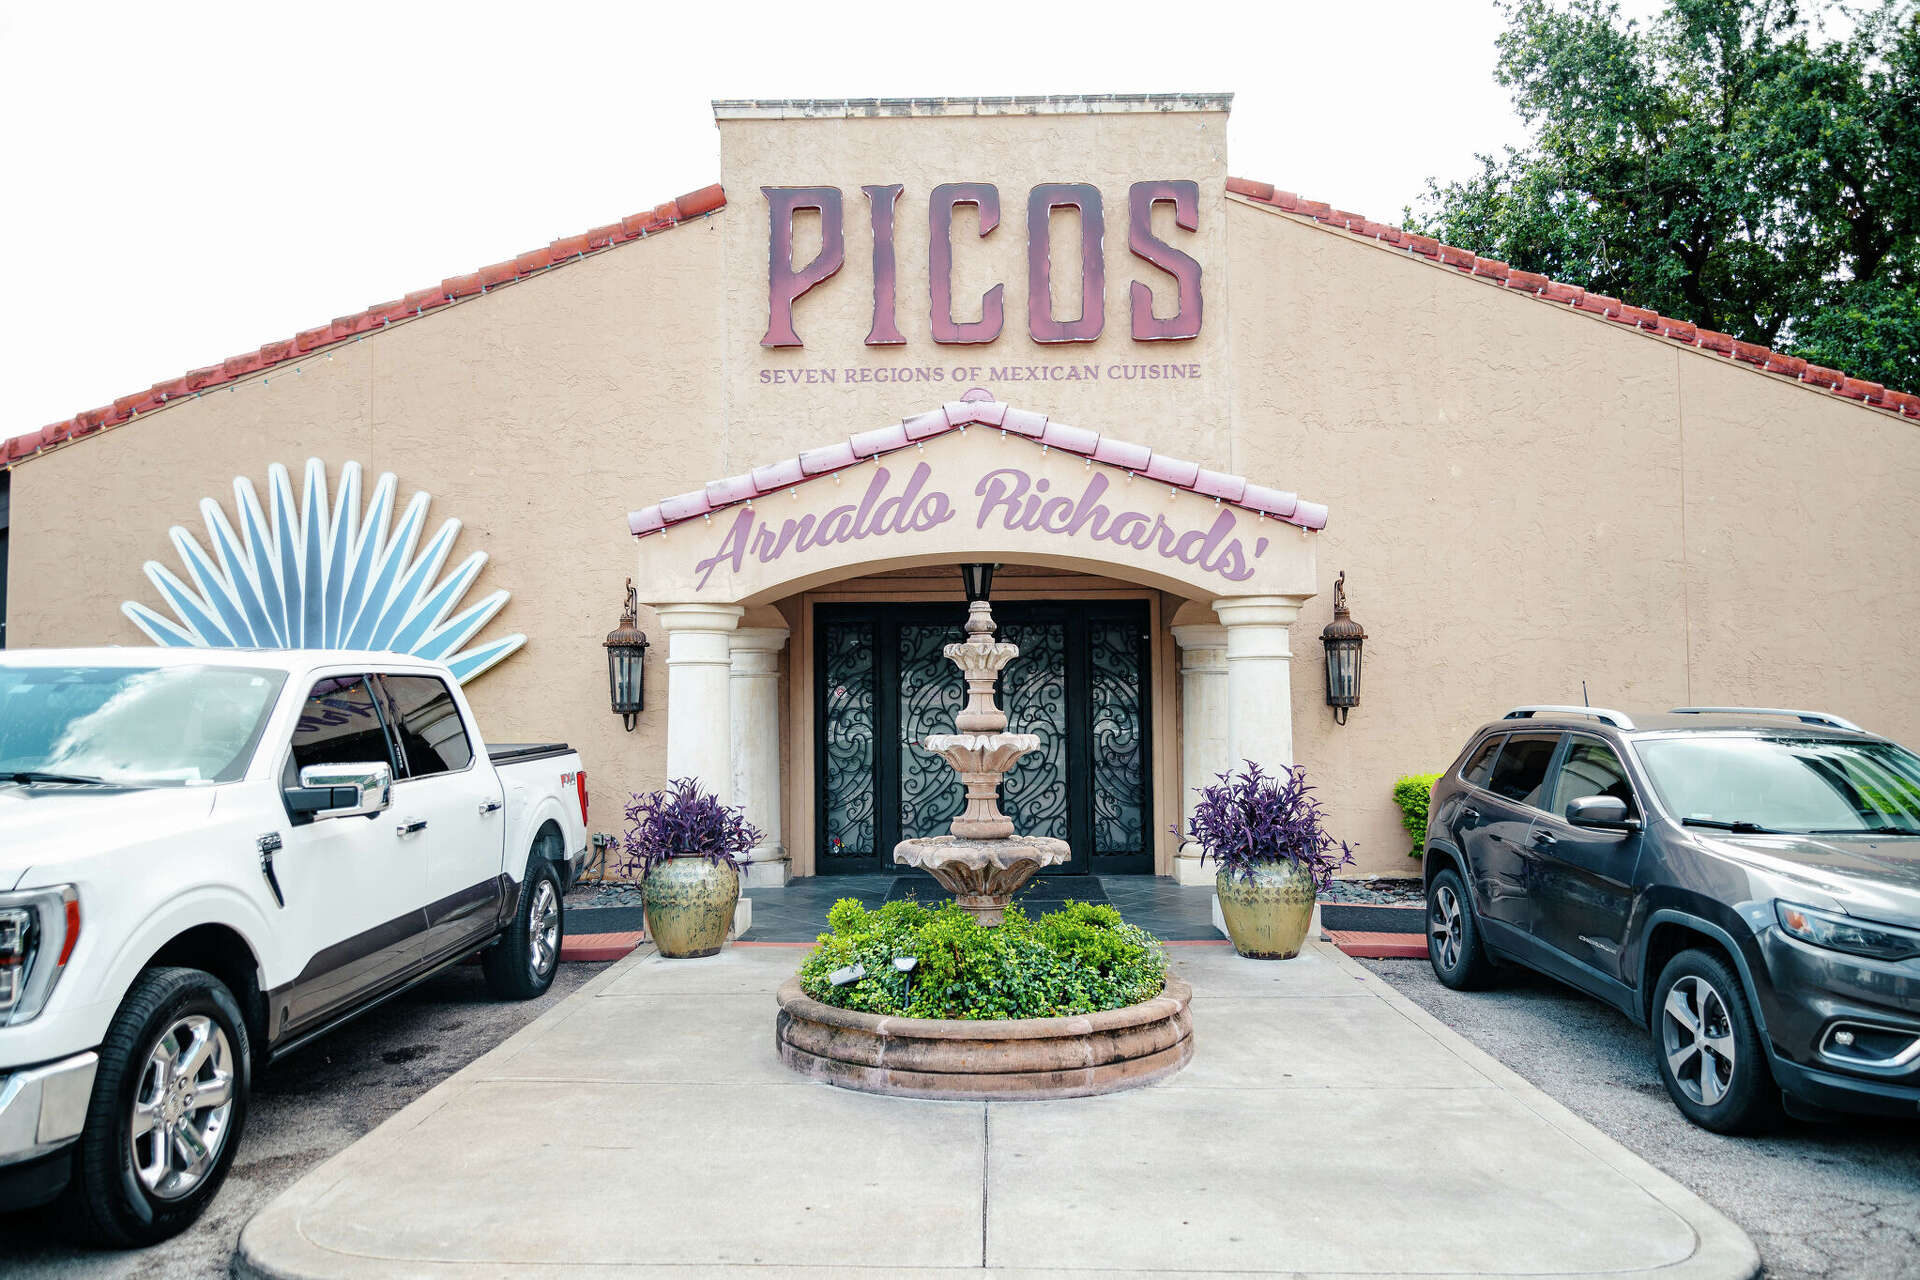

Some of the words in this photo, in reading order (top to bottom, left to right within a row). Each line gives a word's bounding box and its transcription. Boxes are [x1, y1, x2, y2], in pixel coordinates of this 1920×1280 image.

[760, 180, 1203, 347] PICOS
[759, 369, 836, 384] SEVEN
[844, 367, 945, 383] REGIONS
[951, 367, 982, 382] OF
[989, 365, 1100, 381] MEXICAN
[1107, 364, 1201, 380] CUISINE
[695, 461, 956, 592] Arnaldo
[974, 467, 1270, 582] Richards'
